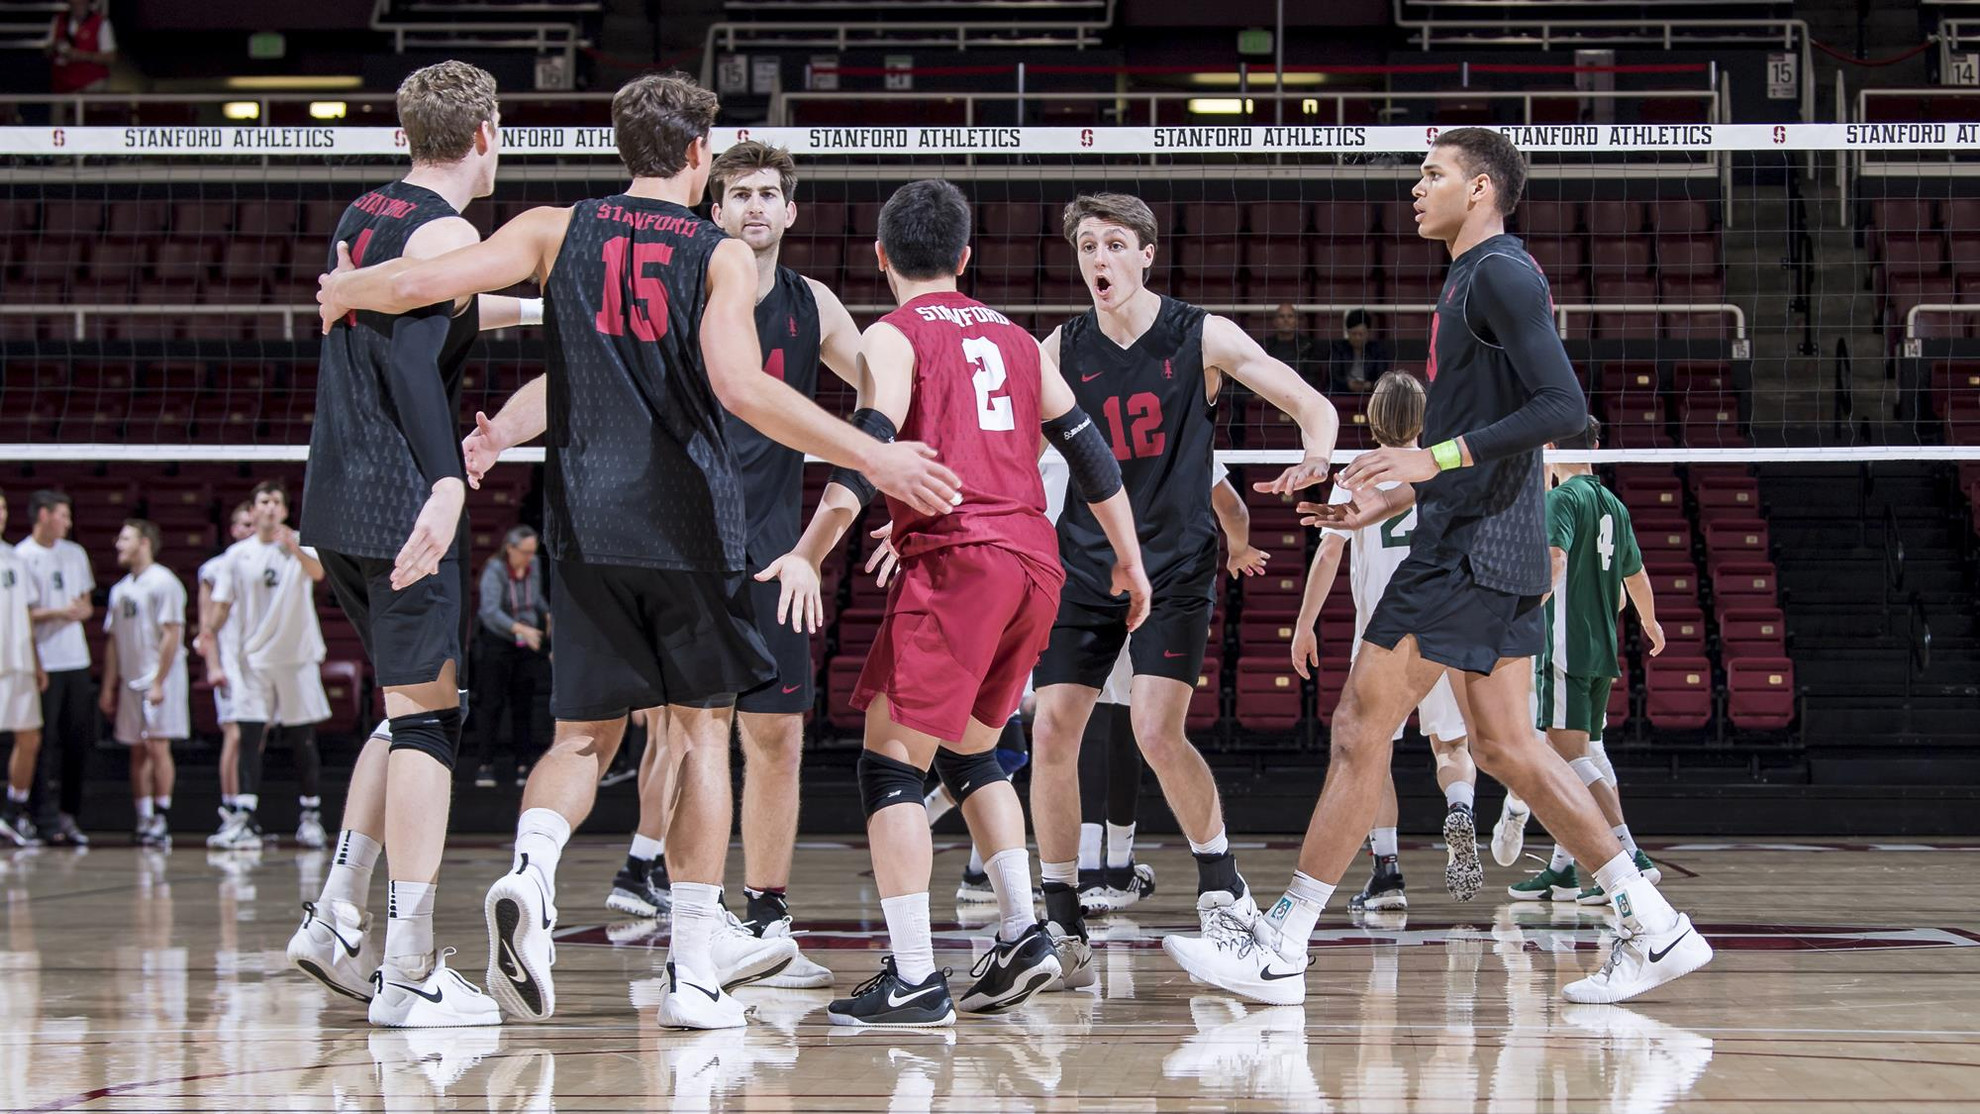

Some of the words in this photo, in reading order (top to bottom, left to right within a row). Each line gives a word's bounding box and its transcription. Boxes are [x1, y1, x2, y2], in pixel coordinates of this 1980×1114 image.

[725, 64, 743, 84] 15
[1772, 64, 1792, 83] 15
[1954, 64, 1975, 83] 14
[125, 128, 222, 148] STANFORD
[233, 128, 334, 148] ATHLETICS
[501, 128, 564, 148] NFORD
[809, 128, 908, 148] STANFORD
[918, 128, 1021, 148] ATHLETICS
[1153, 127, 1252, 148] STANFORD
[1262, 127, 1366, 147] ATHLETICS
[1500, 126, 1598, 146] STANFORD
[1608, 126, 1712, 146] ATHLETICS
[1846, 124, 1946, 144] STANFORD
[596, 236, 674, 342] 15
[961, 336, 1015, 431] 2
[1103, 392, 1166, 460] 12
[1597, 514, 1615, 571] 4
[264, 568, 279, 588] 2
